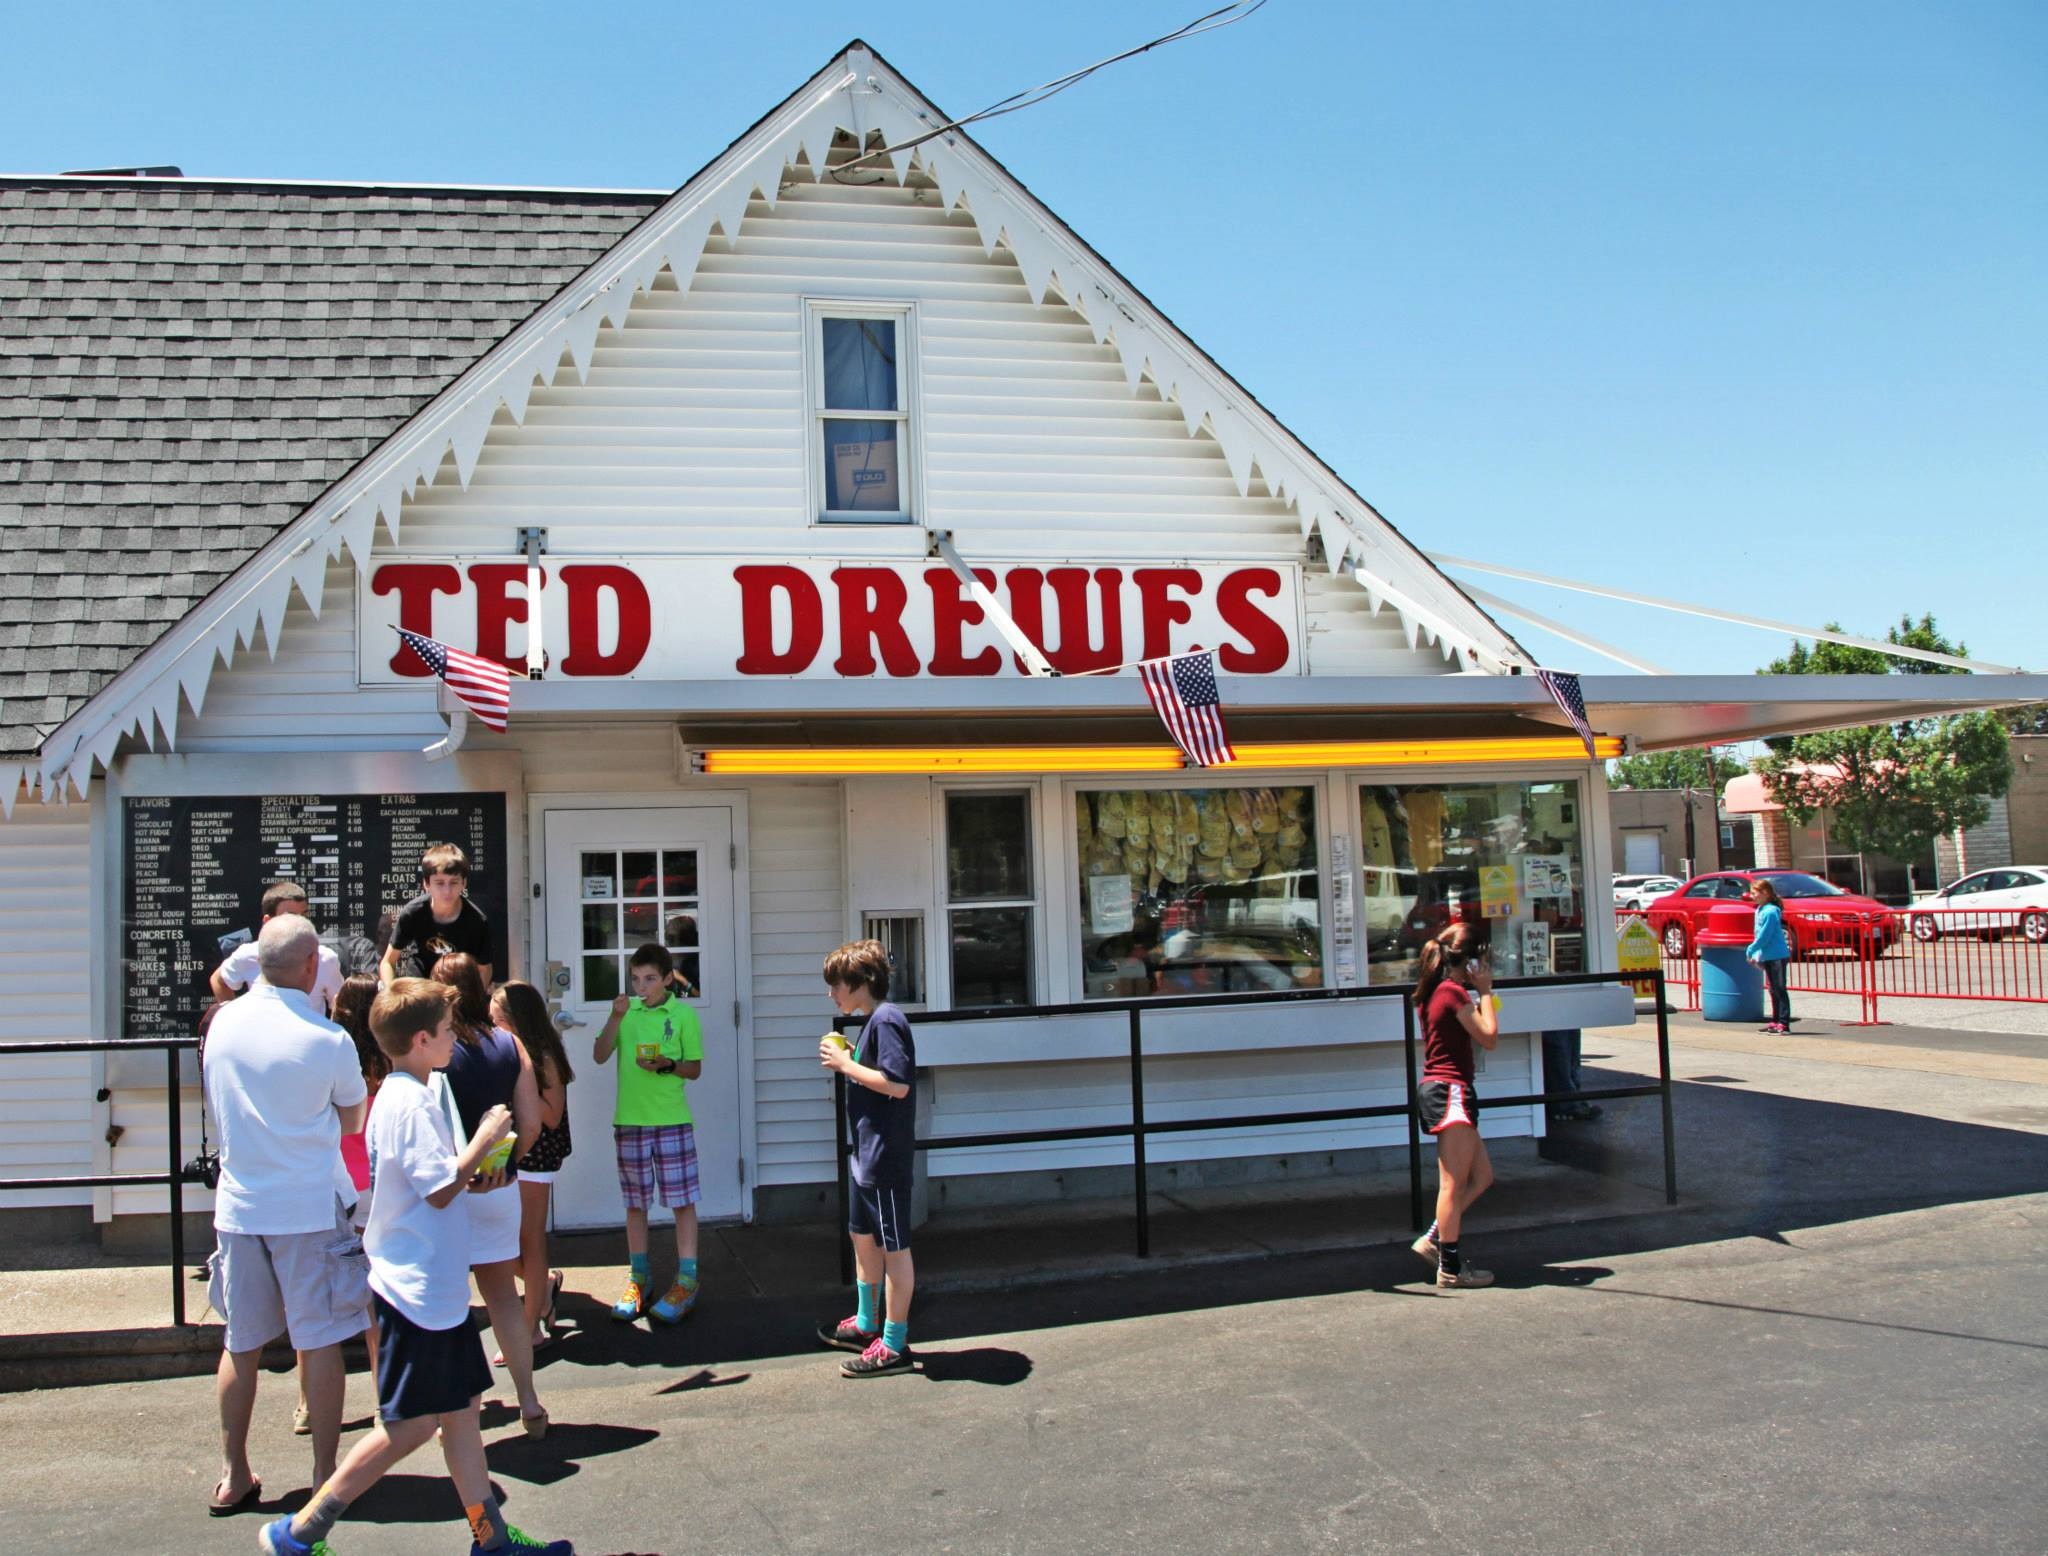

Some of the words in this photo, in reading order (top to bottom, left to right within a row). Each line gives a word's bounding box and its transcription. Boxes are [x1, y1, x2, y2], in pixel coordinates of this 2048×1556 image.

[372, 564, 651, 677] TED
[733, 565, 1289, 676] DREWES
[129, 798, 171, 808] FLAVORS
[262, 796, 320, 806] SPECIALTIES
[381, 795, 416, 804] EXTRAS
[382, 874, 416, 883] FLOATS
[382, 890, 396, 899] ICE
[130, 930, 184, 940] CONCRETES
[129, 962, 165, 972] SHAKES
[174, 961, 204, 970] MALTS
[130, 1013, 161, 1023] CONES
